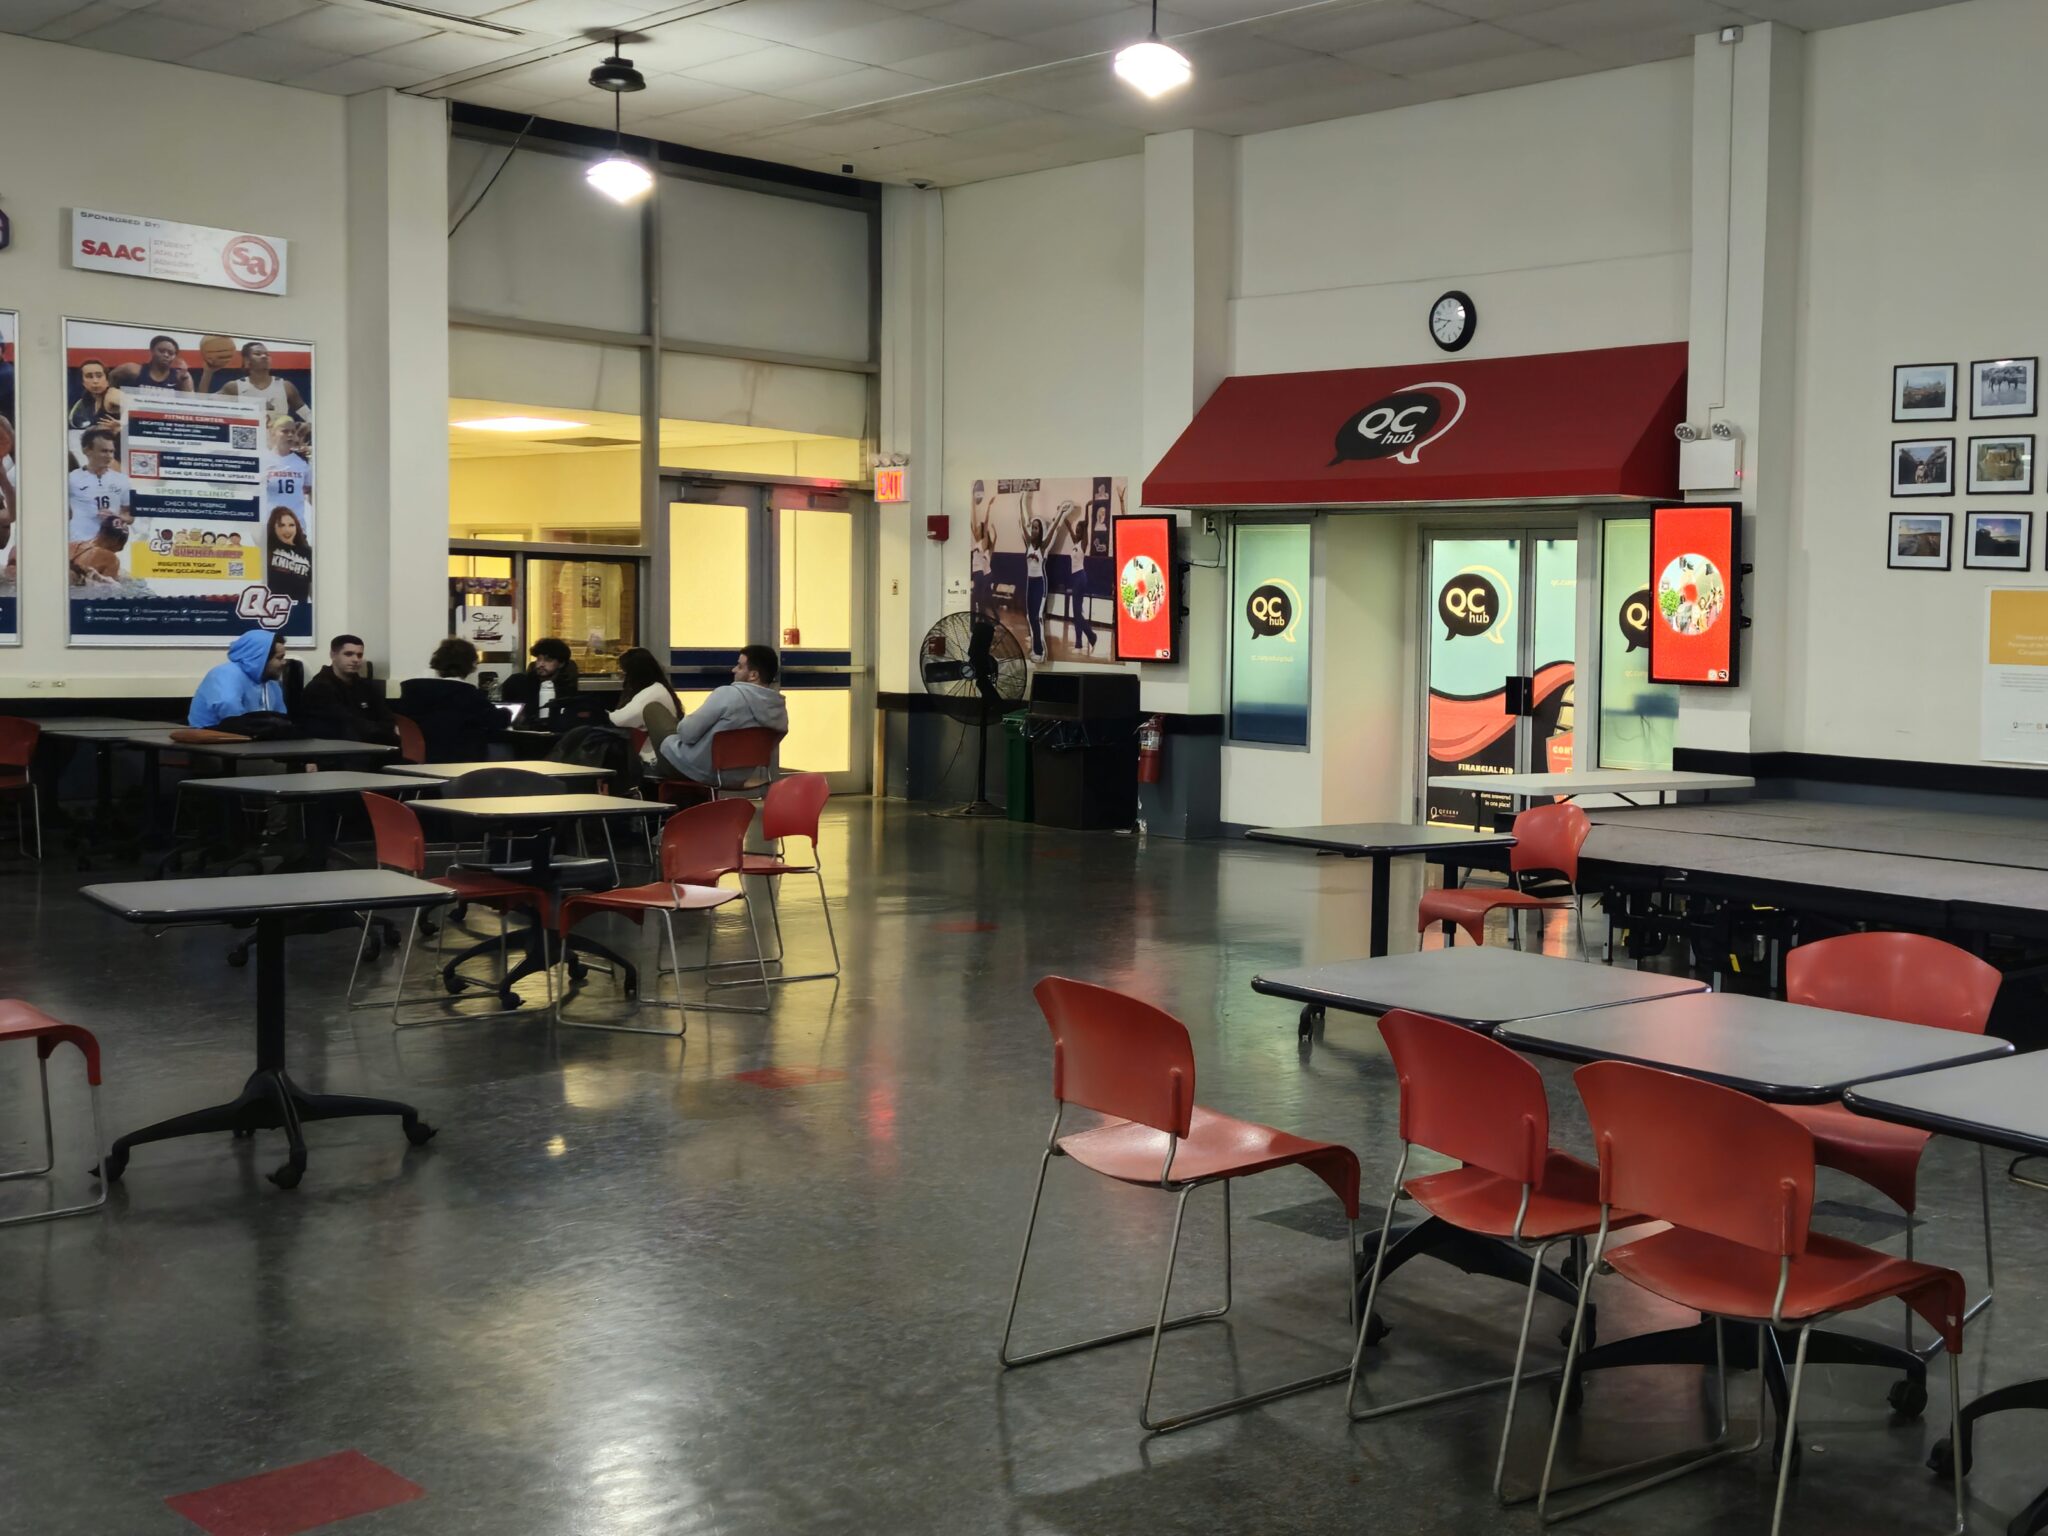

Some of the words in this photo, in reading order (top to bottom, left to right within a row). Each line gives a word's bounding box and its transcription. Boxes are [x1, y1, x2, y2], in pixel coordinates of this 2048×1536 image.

[81, 239, 146, 262] SAAC
[1357, 405, 1428, 439] QC
[1380, 430, 1416, 444] hub
[277, 479, 295, 494] 16
[877, 470, 903, 500] EXIT
[155, 488, 194, 496] SPORTS
[197, 489, 235, 498] CLINICS
[94, 496, 110, 510] 16
[237, 586, 291, 629] QC
[1251, 596, 1282, 621] QC
[1445, 587, 1485, 618] QC
[1269, 615, 1285, 626] hub
[1469, 610, 1489, 623] hub
[1626, 602, 1649, 631] Q
[1552, 745, 1573, 754] CON
[1458, 763, 1498, 774] FINANCIAL
[1499, 766, 1513, 775] AID
